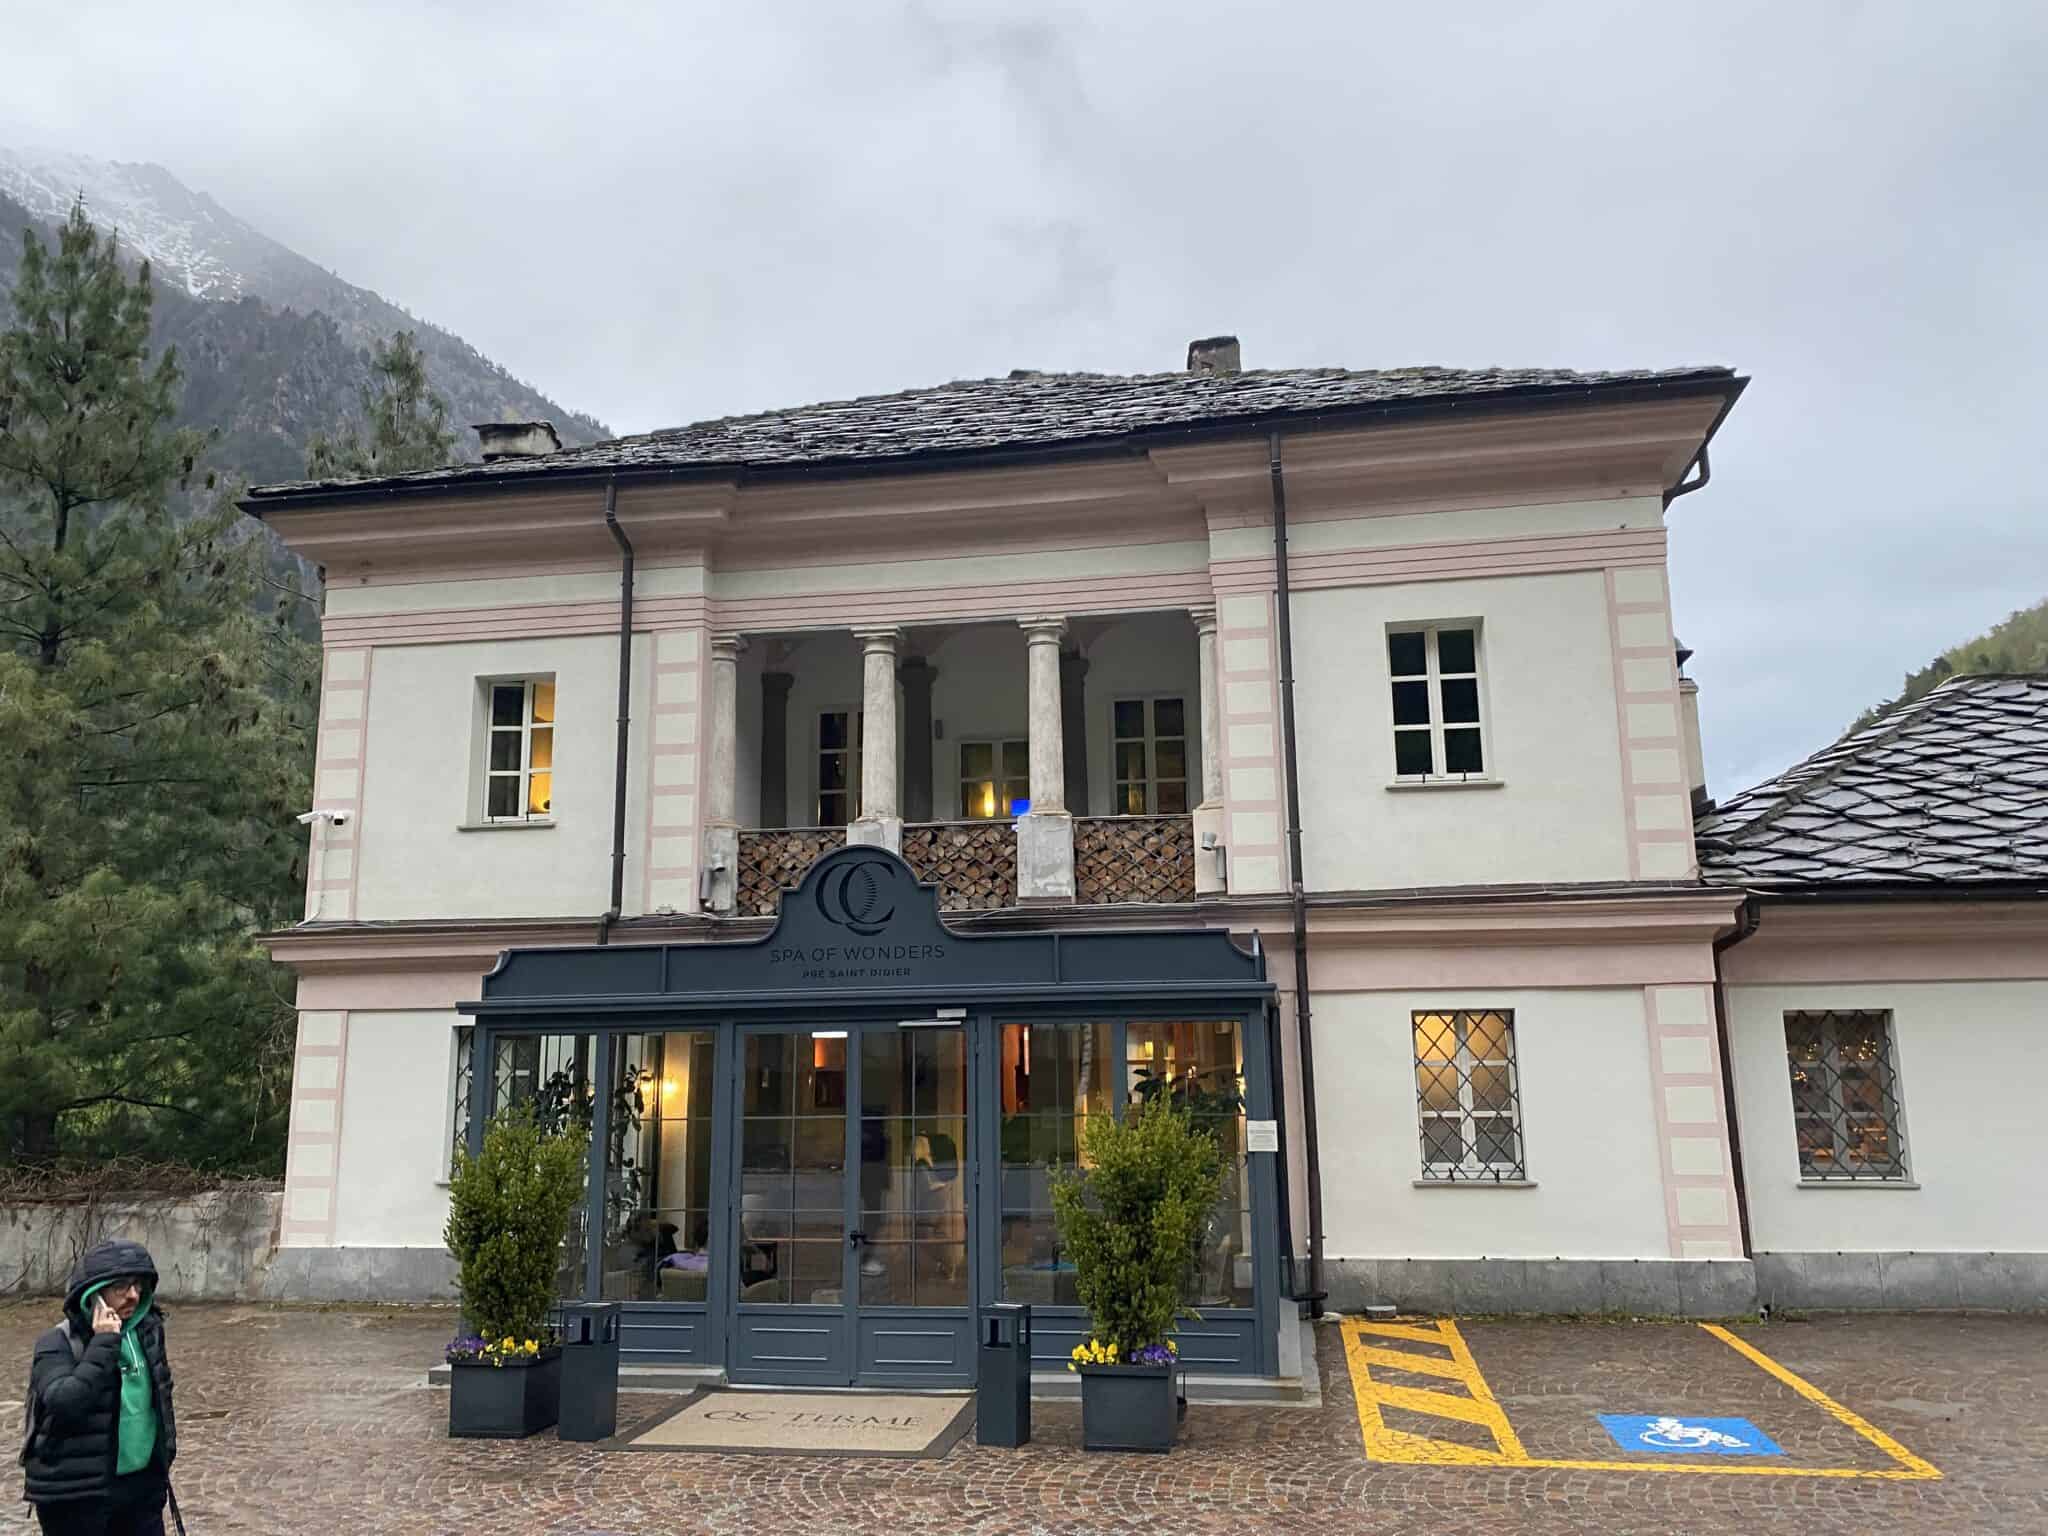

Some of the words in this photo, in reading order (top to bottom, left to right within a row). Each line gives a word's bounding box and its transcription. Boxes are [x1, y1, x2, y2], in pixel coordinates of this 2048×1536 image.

[769, 948, 805, 963] SPA
[811, 946, 841, 961] OF
[843, 944, 946, 960] WONDERS
[829, 968, 865, 978] SAINT
[870, 967, 911, 977] DIDIER
